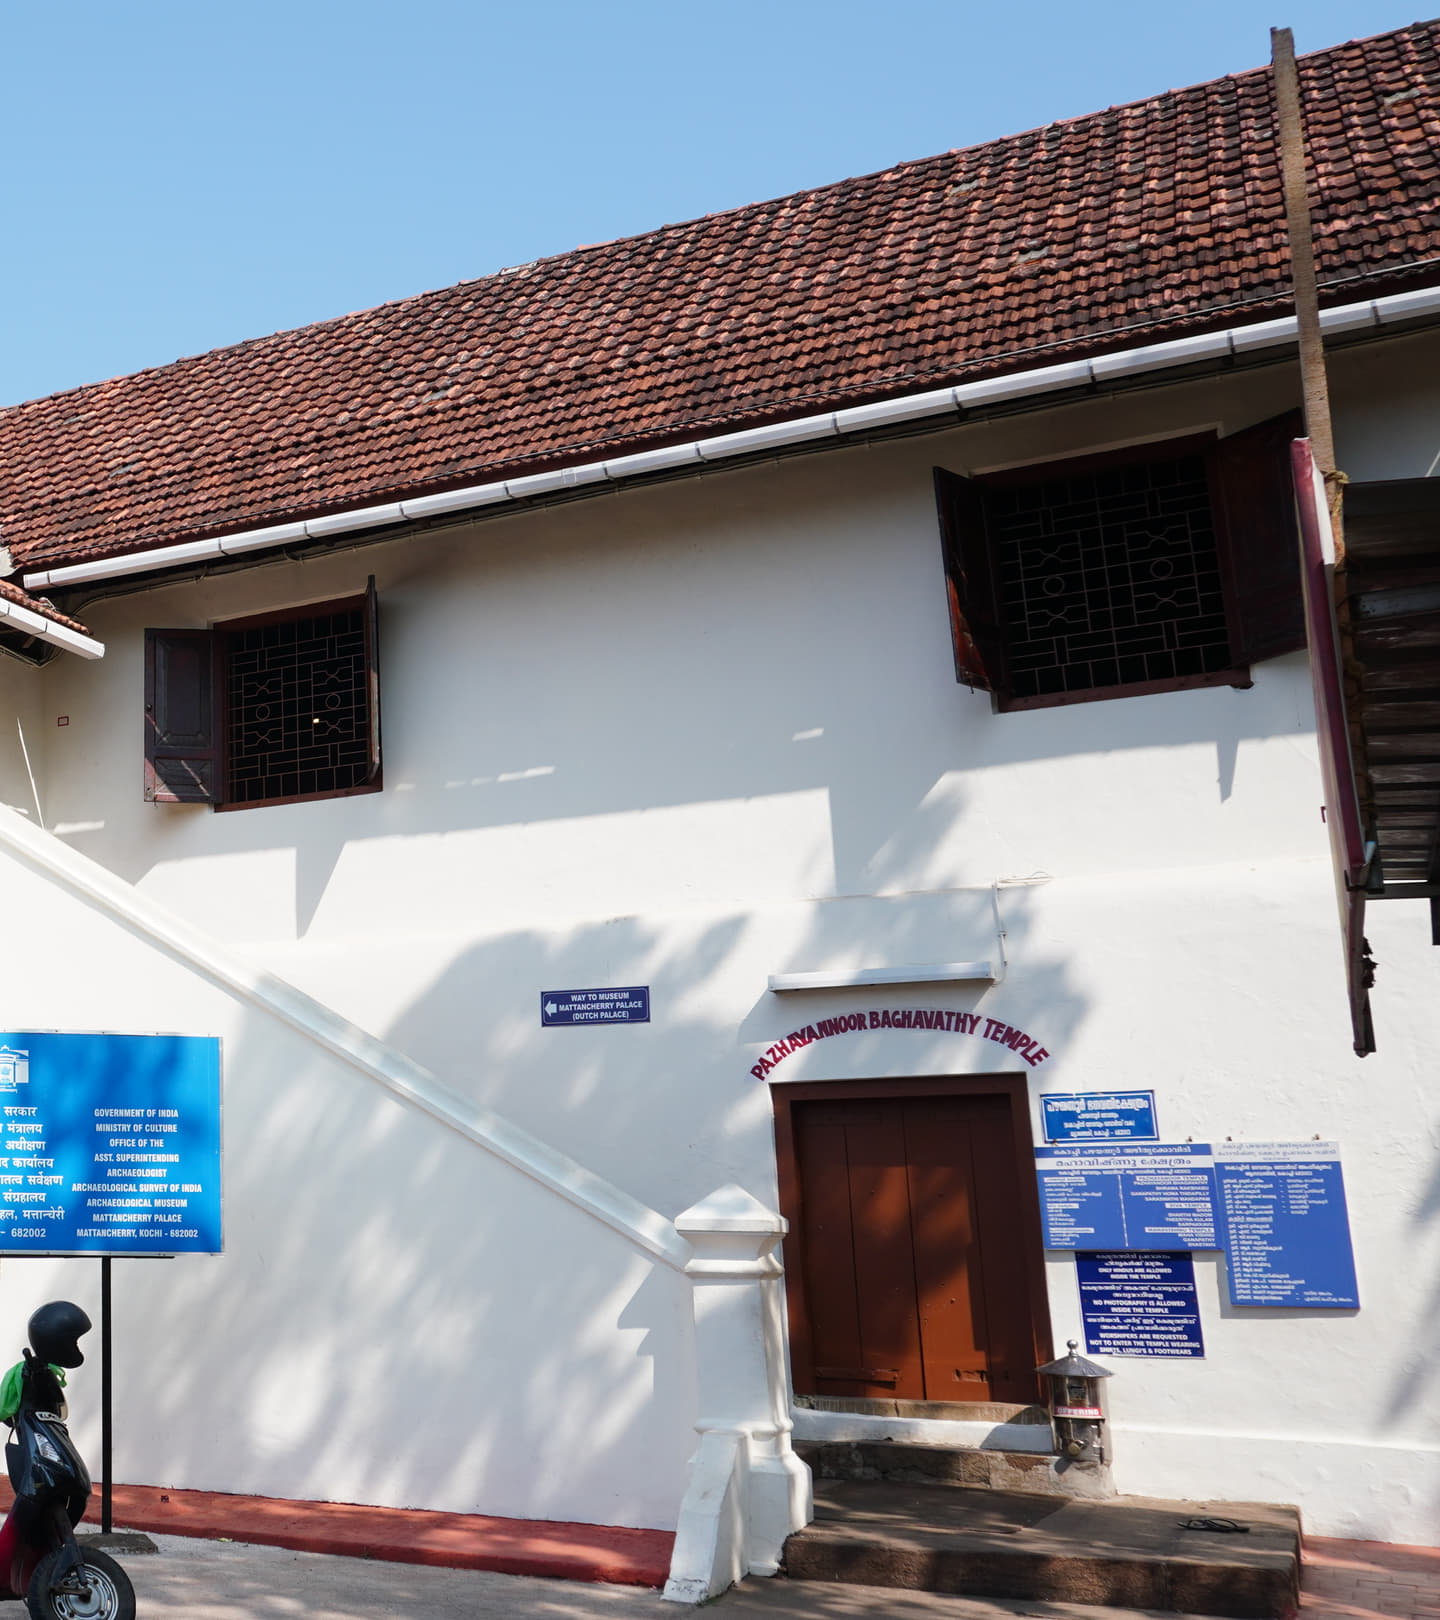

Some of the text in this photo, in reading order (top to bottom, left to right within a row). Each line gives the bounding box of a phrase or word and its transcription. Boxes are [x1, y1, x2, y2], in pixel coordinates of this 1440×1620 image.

[571, 992, 630, 1002] WAY TO MUSEUM
[559, 1000, 643, 1012] MATTANCHERRY PALACE
[572, 1010, 630, 1022] (DUTCH PALACE)
[750, 1010, 1050, 1082] PAZHAYANNOOR BAGHAVATHY TEMPLE
[3, 1106, 38, 1116] सरकार
[94, 1109, 179, 1117] GOVERNMENT OF INDIA
[7, 1120, 43, 1133] मंत्रालय
[96, 1123, 177, 1132] MINISTRY OF CULTURE
[5, 1137, 46, 1151] अधीक्षण
[109, 1138, 164, 1147] OFFICE OF THE
[12, 1154, 55, 1168] कार्यालय
[94, 1154, 179, 1163] ASST. SUPERINTENDING
[107, 1168, 167, 1177] ARCHAEOLOGIST
[27, 1171, 63, 1185] सर्वेक्षण
[72, 1183, 202, 1192] ARCHAEOLOGICAL SURVEY OF INDIA
[3, 1189, 47, 1203] संग्रहालय
[87, 1198, 188, 1207] ARCHAEOLOGICAL MUSEUM
[92, 1213, 182, 1222] MATTANCHERRY PALACE
[11, 1228, 46, 1237] 682002
[76, 1228, 137, 1238] MATTANCHERRY,
[139, 1229, 162, 1238] KOCHI
[170, 1229, 198, 1238] 682002
